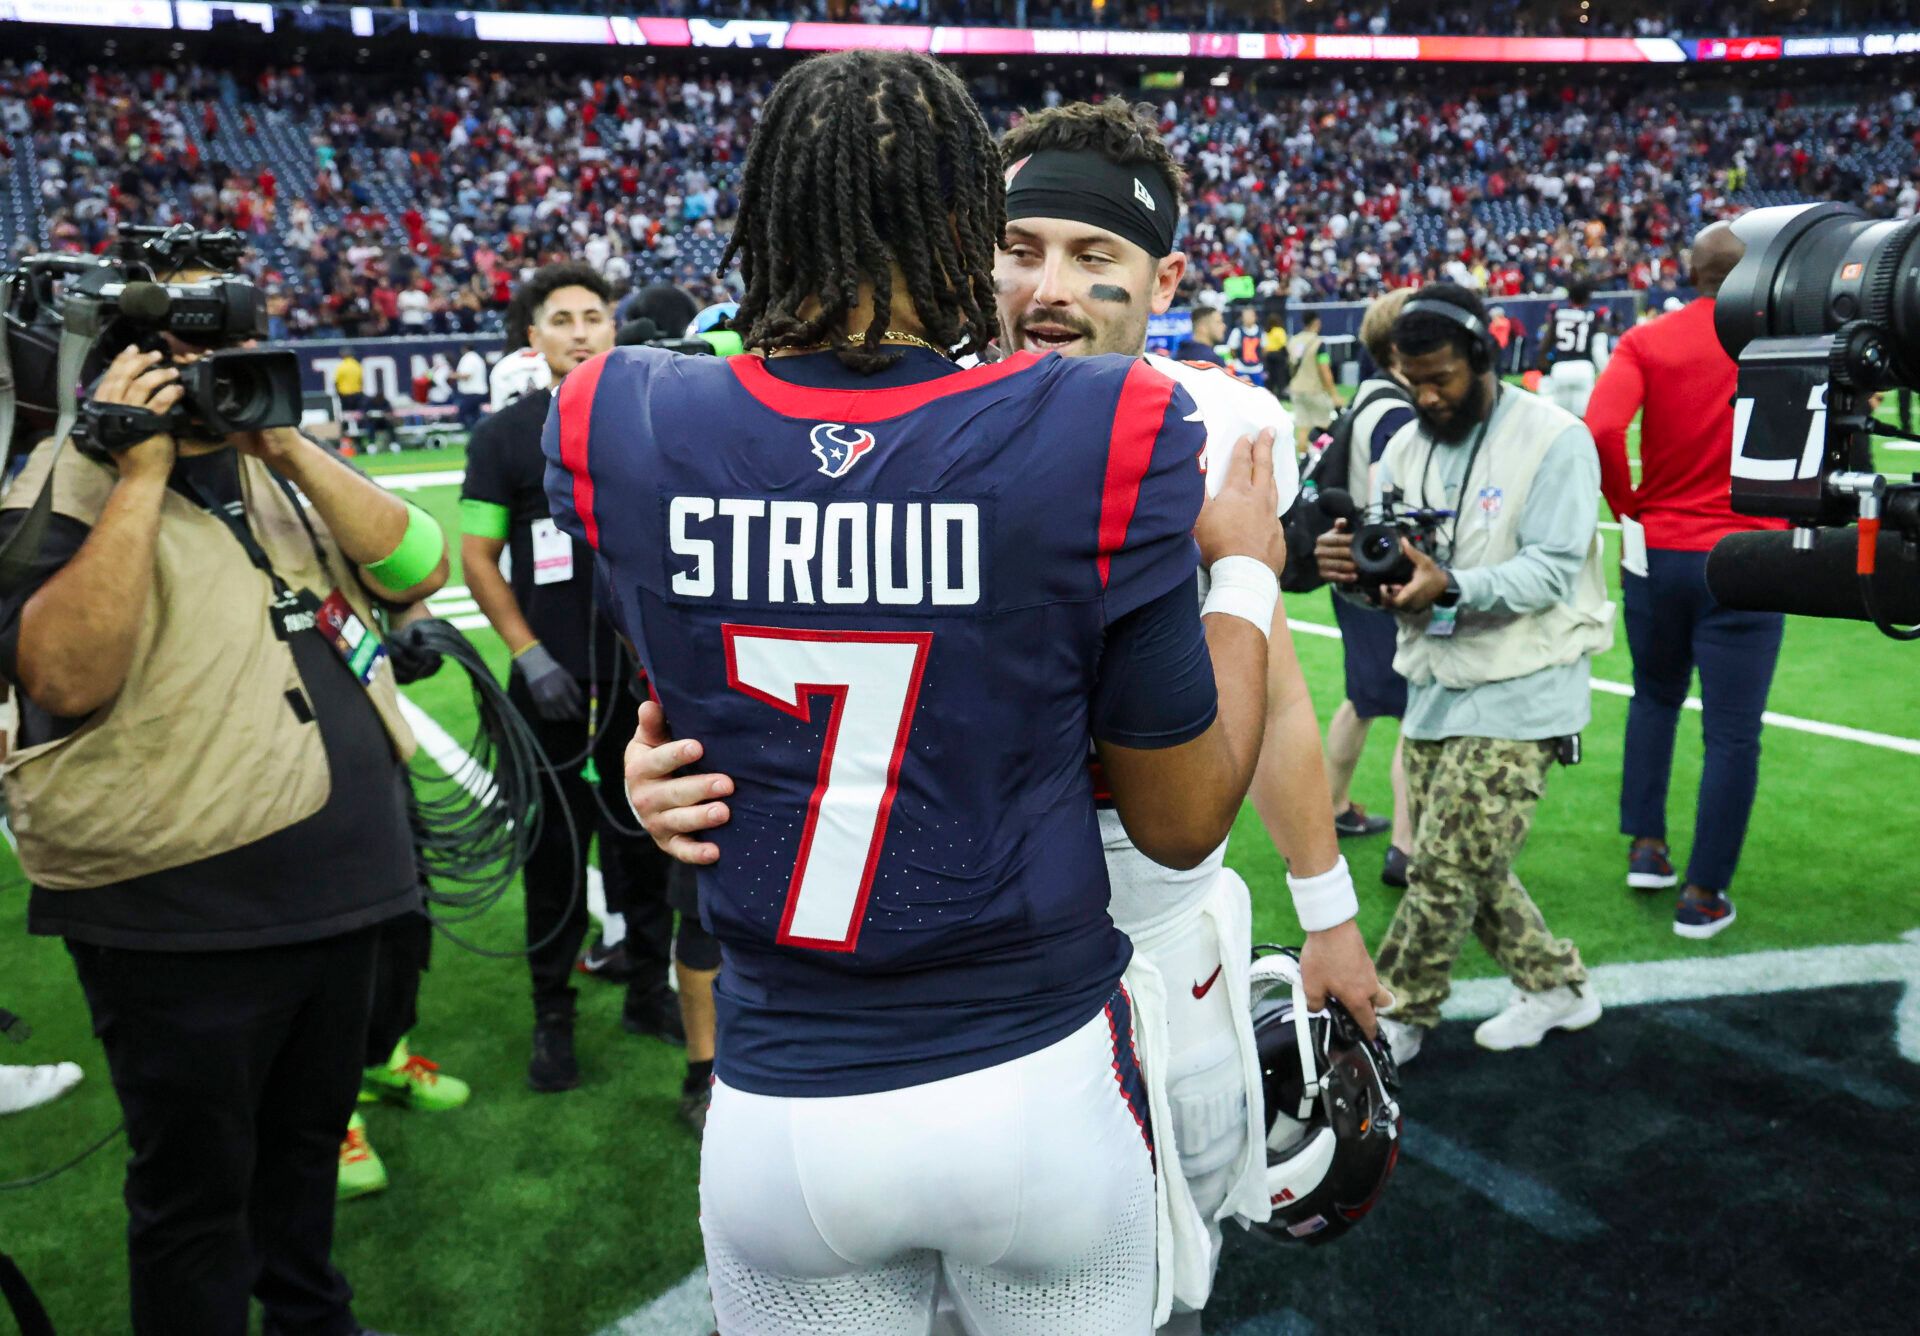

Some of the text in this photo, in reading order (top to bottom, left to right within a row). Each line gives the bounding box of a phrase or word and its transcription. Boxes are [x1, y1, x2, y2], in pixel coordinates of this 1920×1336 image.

[1556, 320, 1589, 352] 51
[670, 496, 980, 605] STROUD
[721, 622, 934, 952] 7
